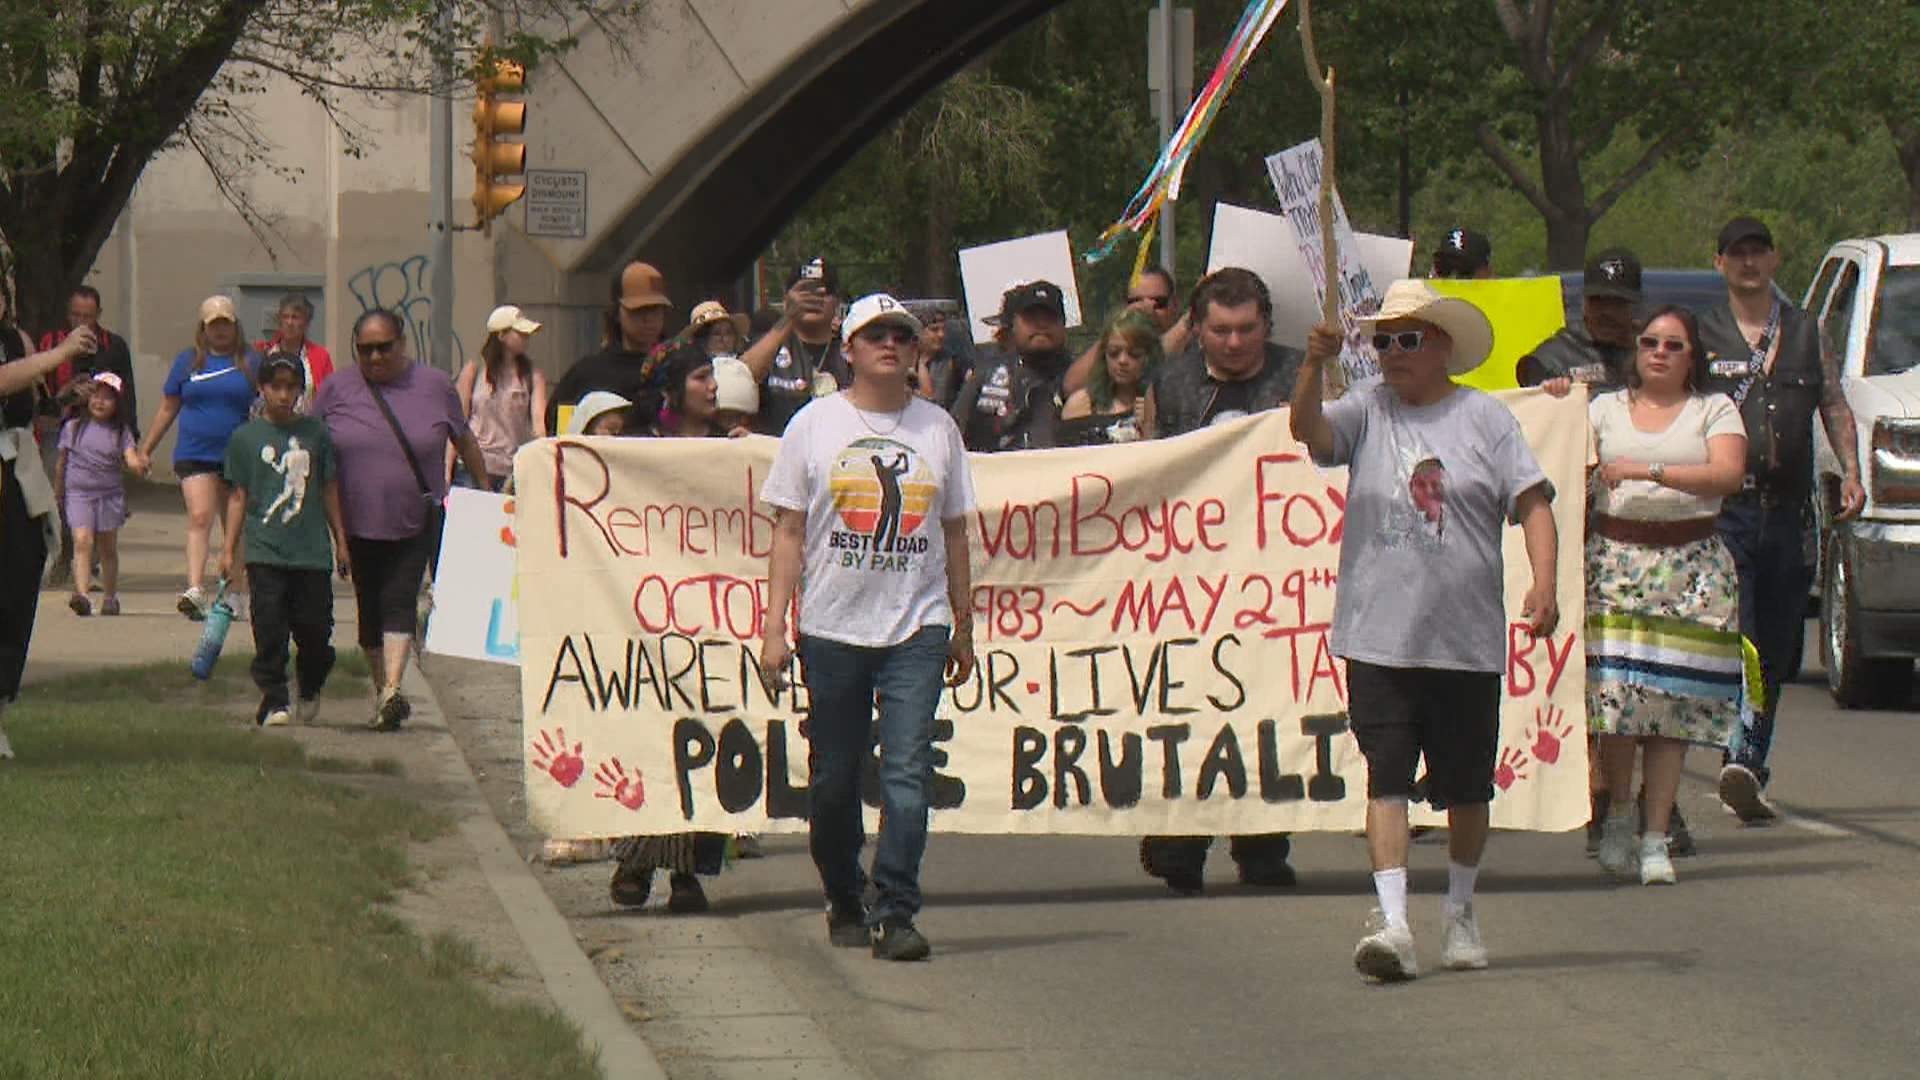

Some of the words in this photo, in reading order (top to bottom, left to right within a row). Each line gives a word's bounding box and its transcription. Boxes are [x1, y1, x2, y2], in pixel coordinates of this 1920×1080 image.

[555, 441, 777, 558] Rememb
[978, 500, 1060, 562] von
[1071, 472, 1228, 562] Boyce
[829, 531, 873, 551] BEST
[896, 536, 929, 554] DAD
[841, 551, 866, 570] BY
[870, 554, 909, 573] PAR
[971, 585, 1044, 642] 983
[1111, 572, 1229, 635] MAY
[1049, 633, 1246, 722] LIVES
[1508, 622, 1576, 697] BY
[1011, 711, 1348, 810] BRUTALI
